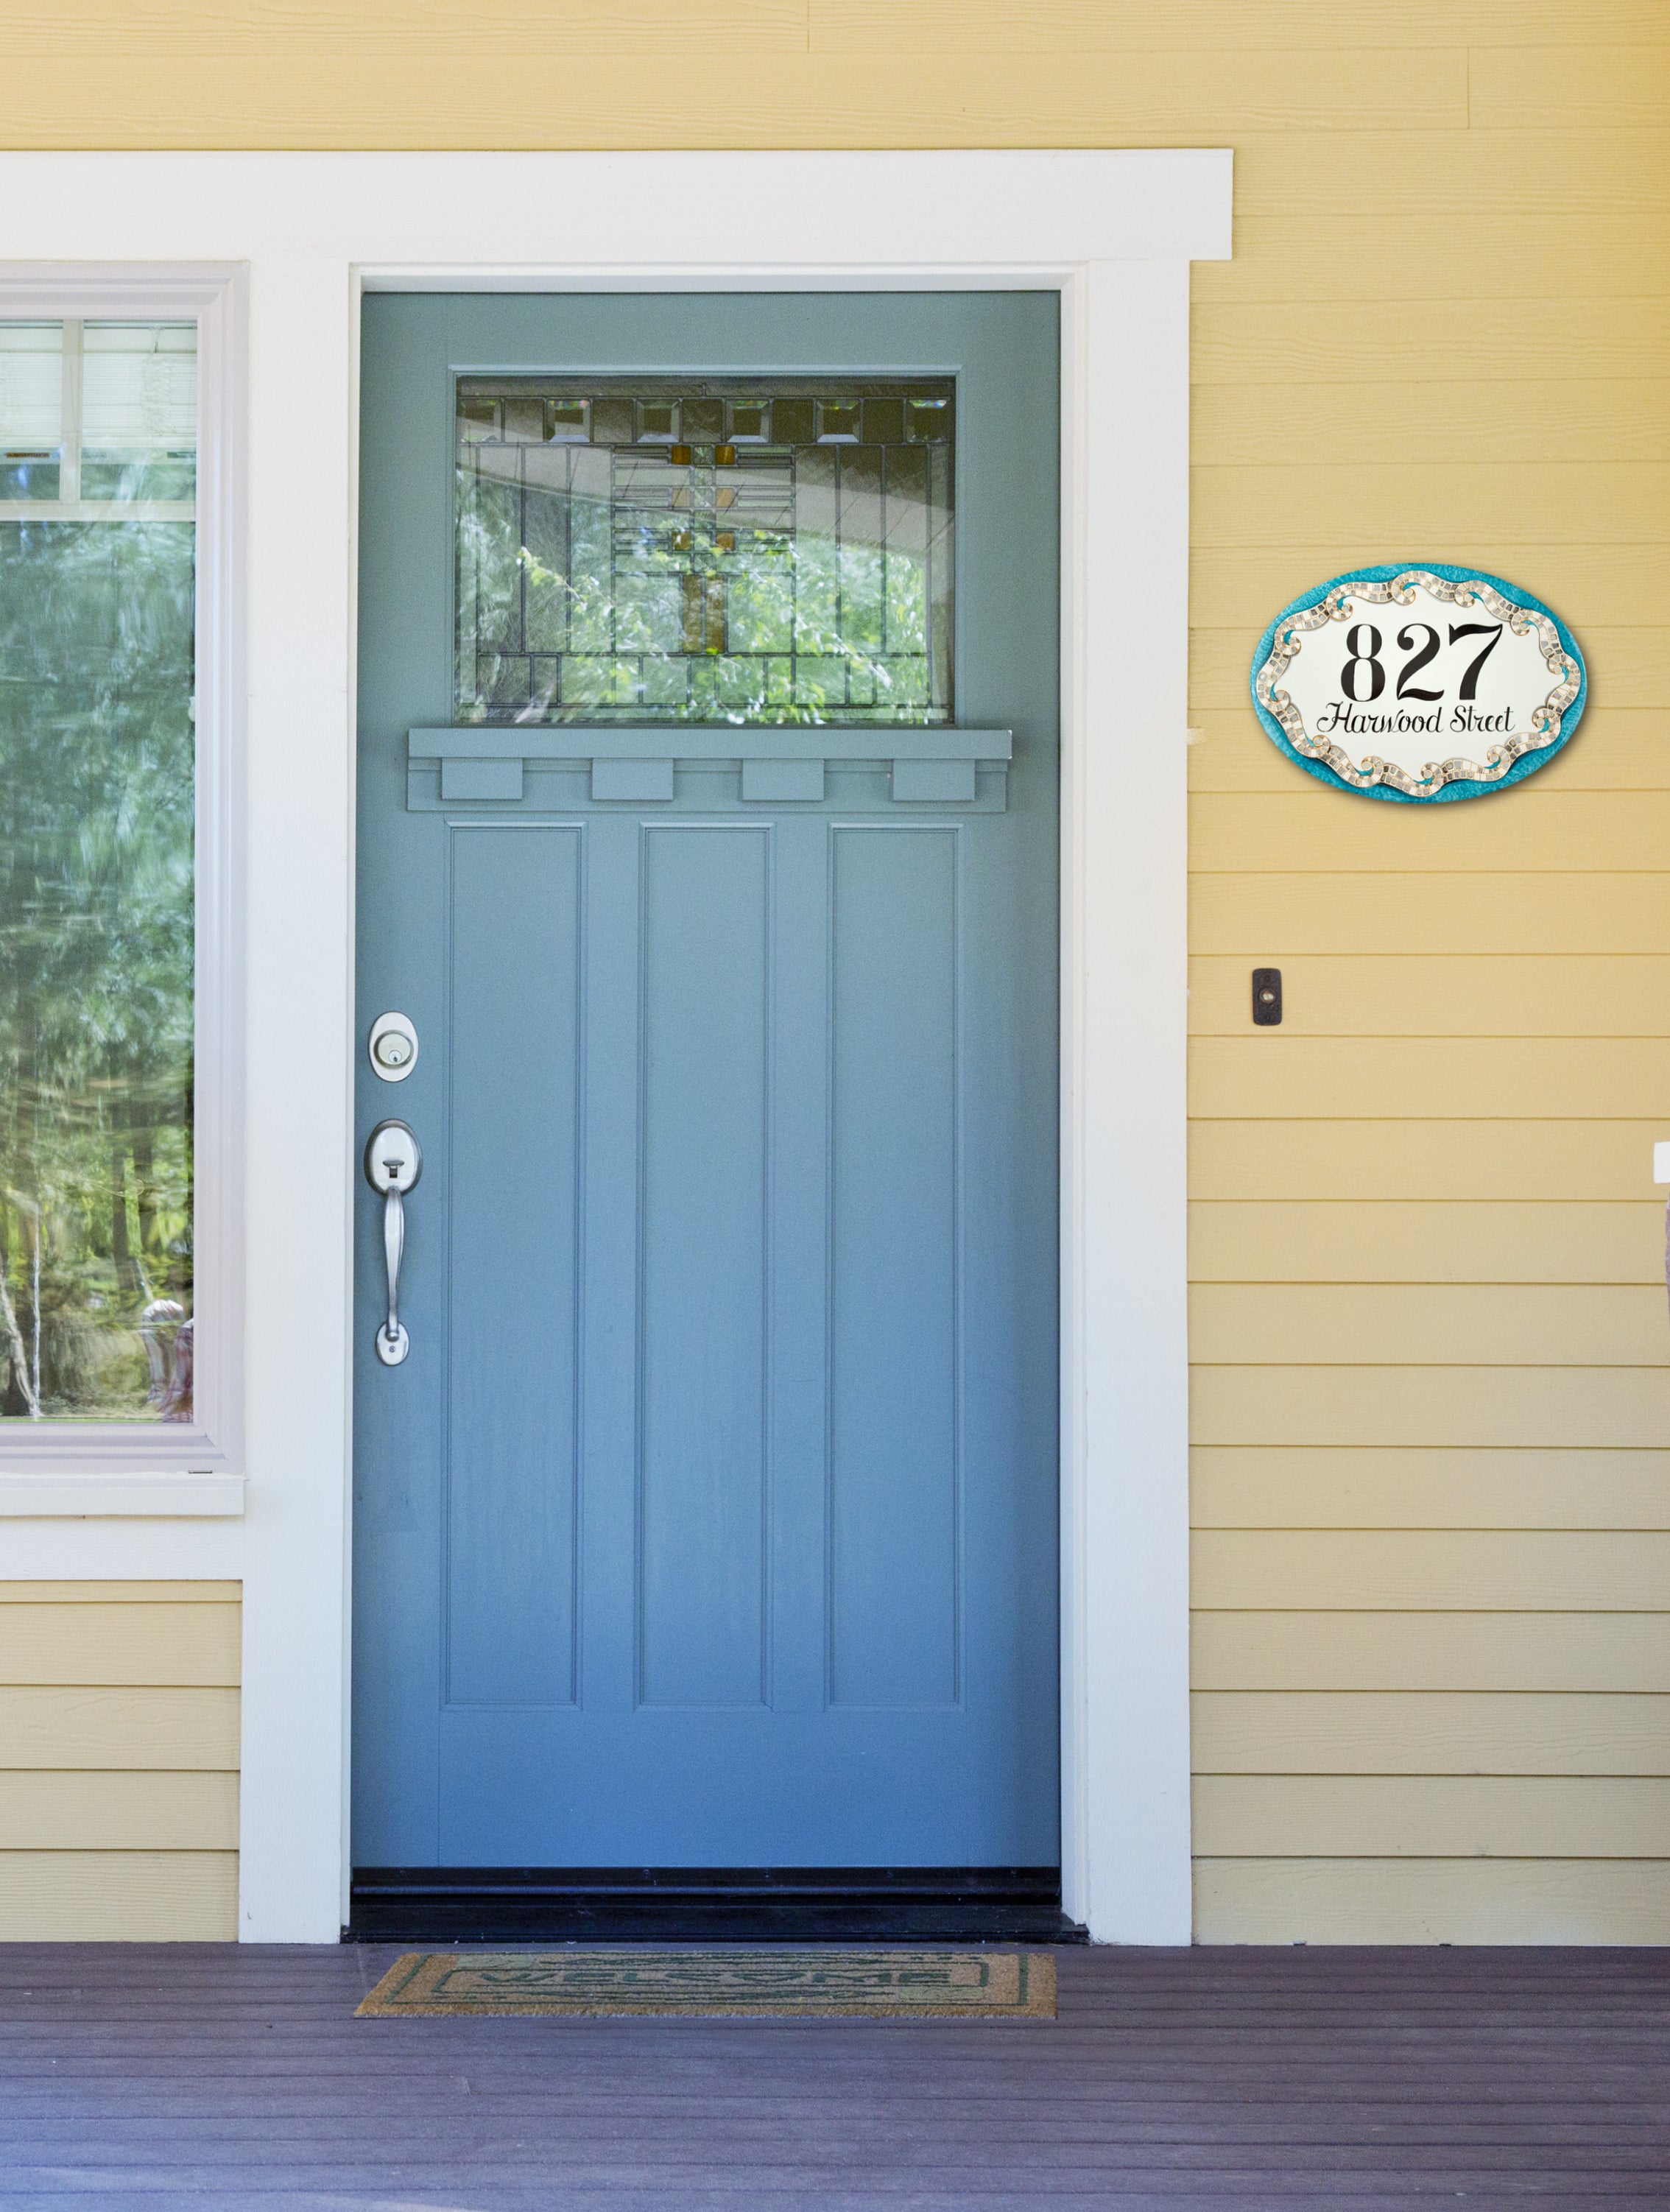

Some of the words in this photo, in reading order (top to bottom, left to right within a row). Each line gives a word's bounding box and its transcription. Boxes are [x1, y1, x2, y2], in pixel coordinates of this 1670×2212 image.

[1341, 623, 1503, 702] 827
[1317, 702, 1444, 733] Harwood
[1449, 705, 1515, 733] Street
[479, 1972, 952, 1984] WELCOME
